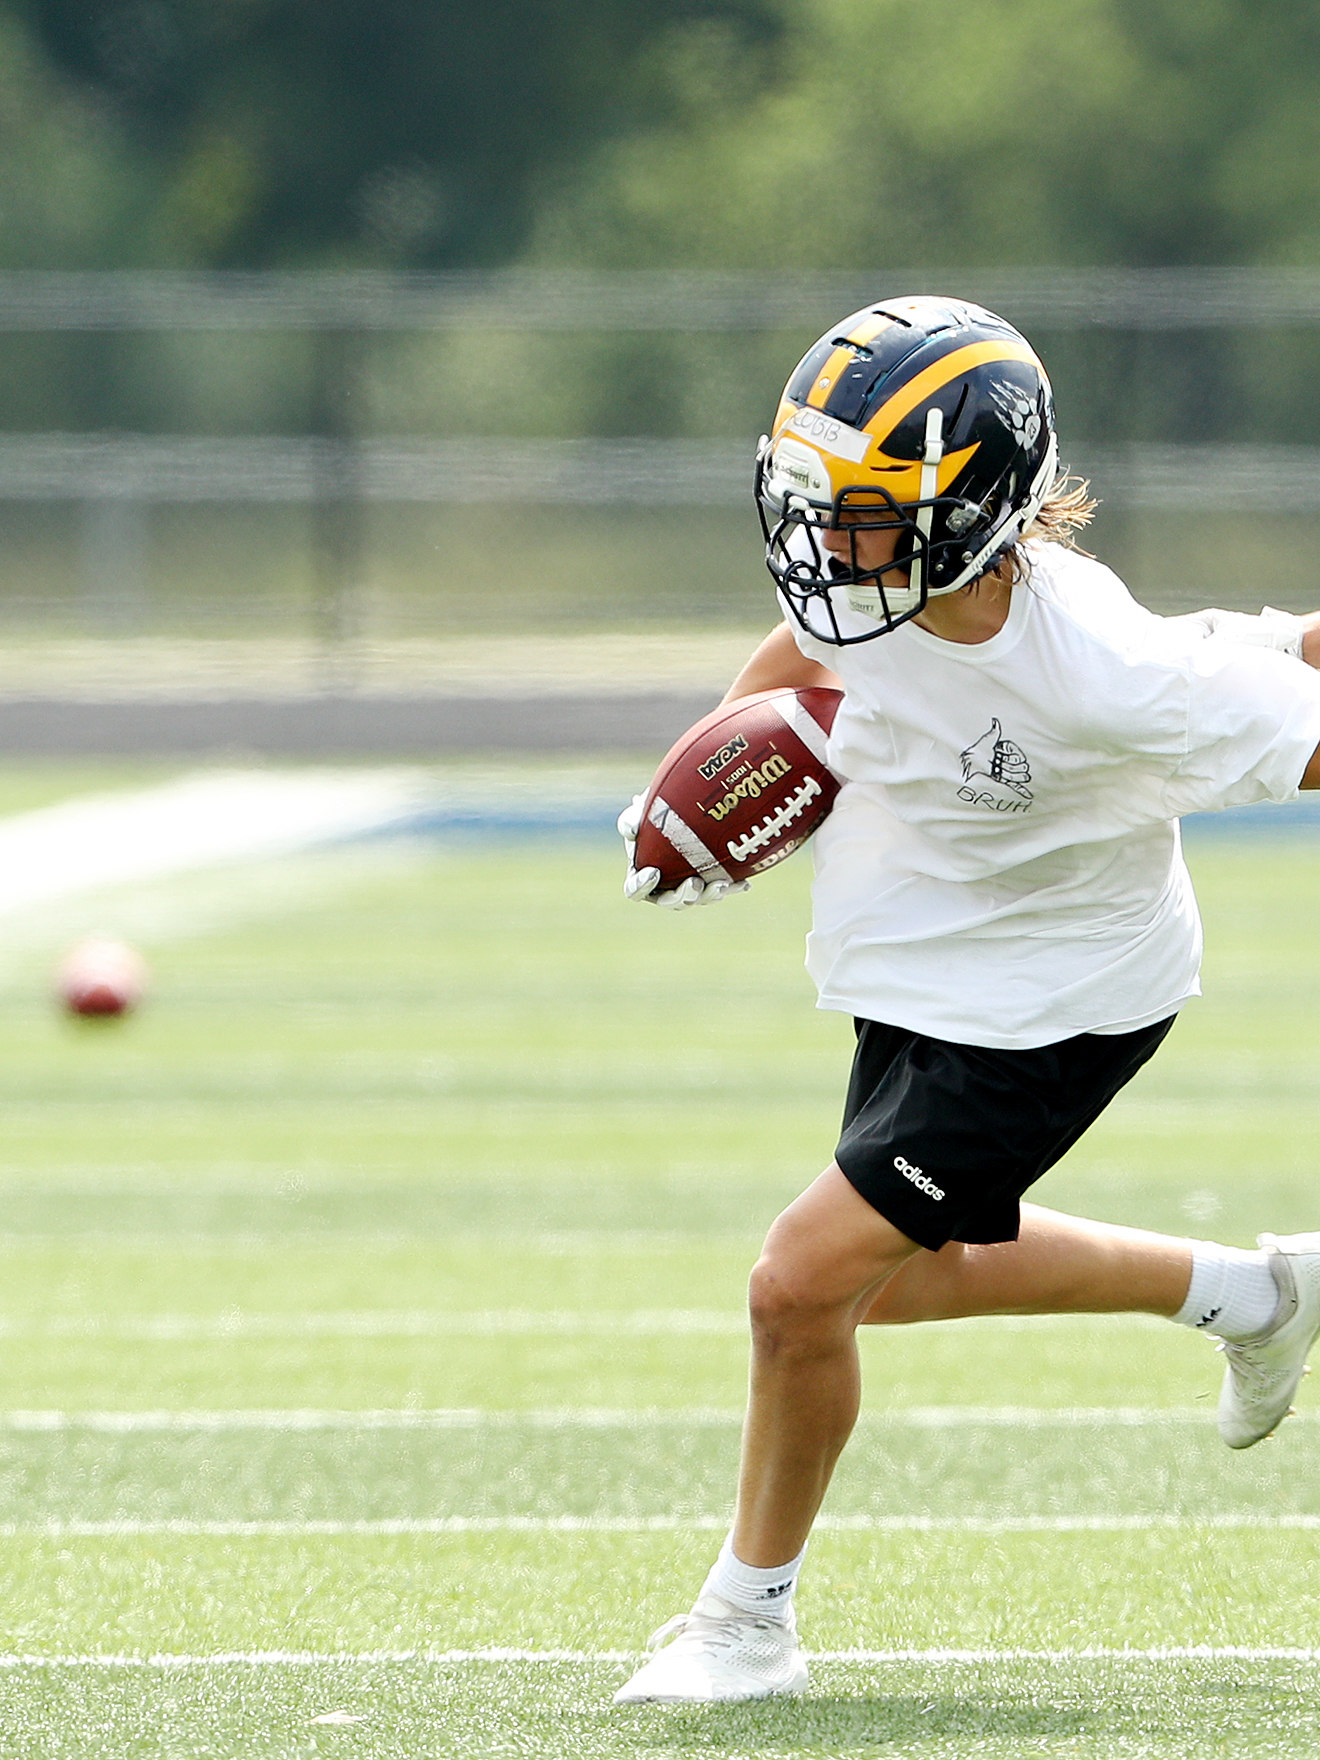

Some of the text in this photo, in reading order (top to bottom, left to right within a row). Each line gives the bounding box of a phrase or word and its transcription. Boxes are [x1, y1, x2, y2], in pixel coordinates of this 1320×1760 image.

[698, 733, 749, 781] NCAA
[726, 764, 747, 785] 1005
[707, 753, 792, 821] Wilson
[893, 1156, 946, 1202] adidas
